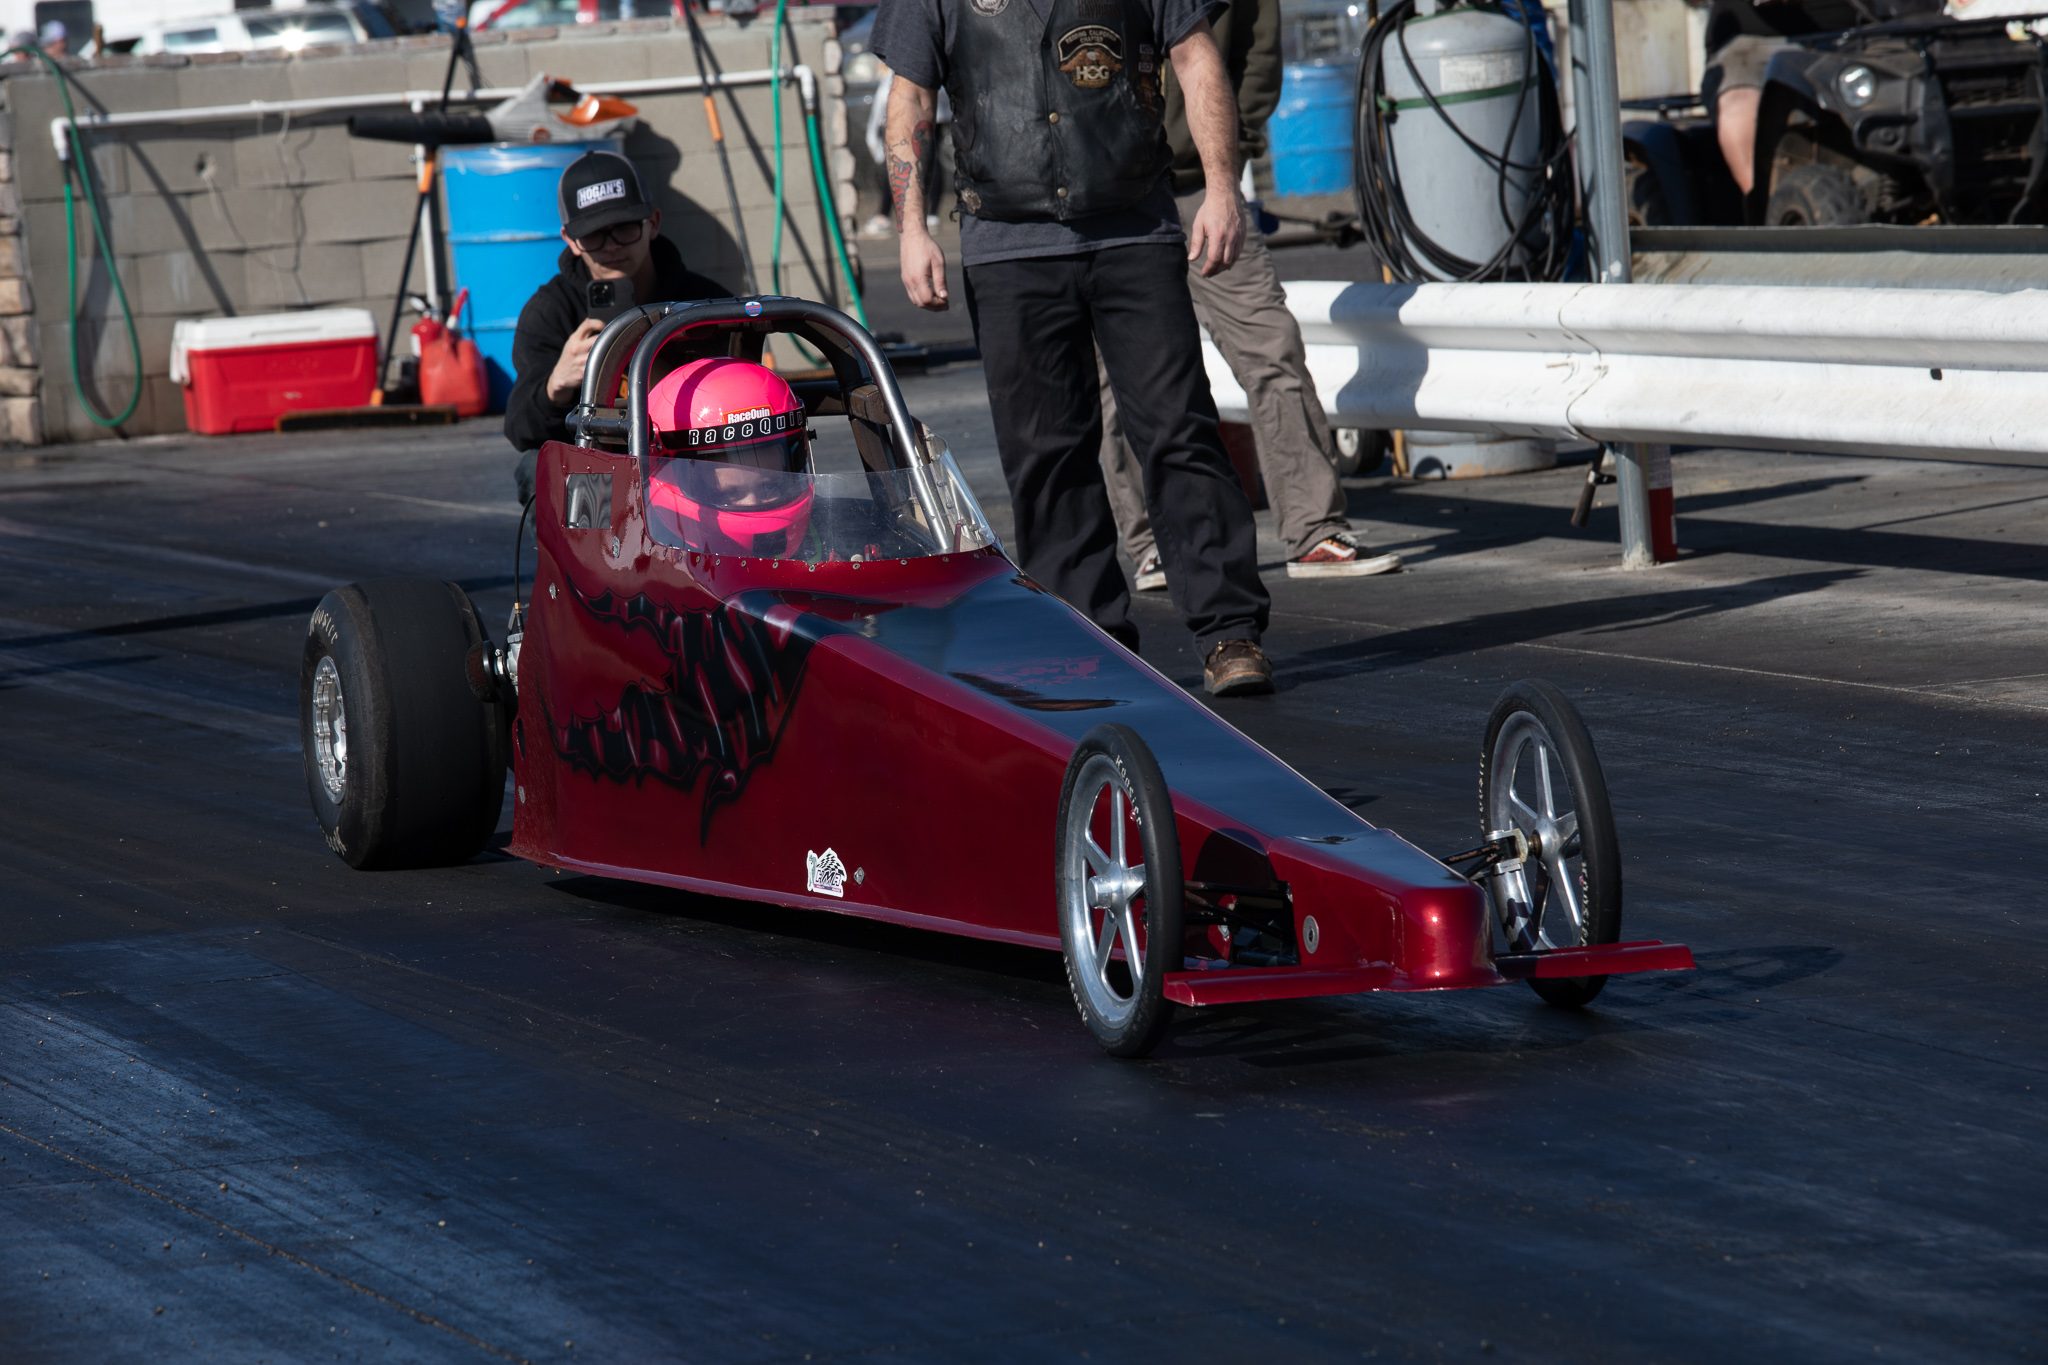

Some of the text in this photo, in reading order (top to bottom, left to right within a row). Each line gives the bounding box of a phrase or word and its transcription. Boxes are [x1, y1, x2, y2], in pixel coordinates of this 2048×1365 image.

[1080, 36, 1104, 44] CHAPTER
[1088, 30, 1118, 43] CALIFORNIA
[1076, 65, 1110, 80] HOG
[580, 180, 623, 203] HOGAN'S
[688, 411, 804, 446] RaceQuip
[1115, 754, 1142, 826] Hoosier
